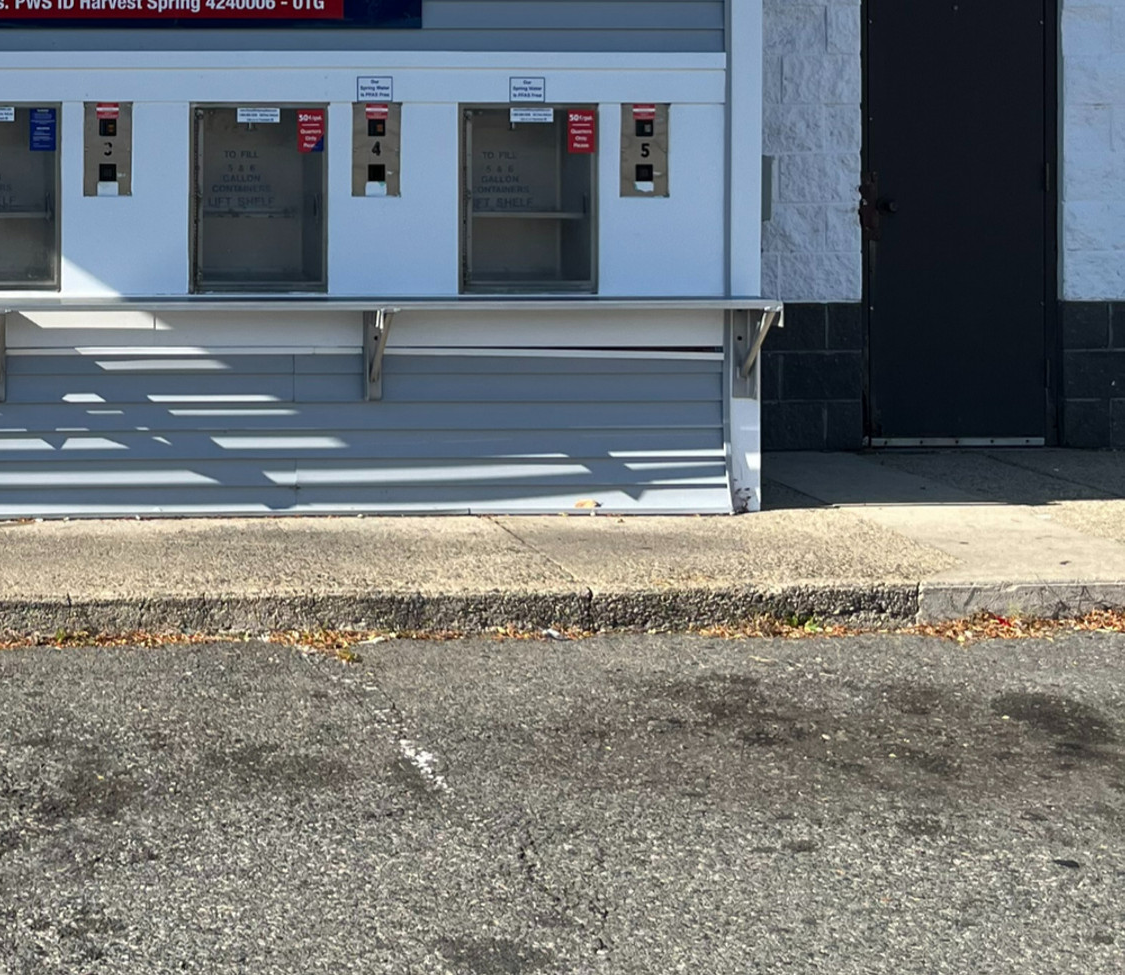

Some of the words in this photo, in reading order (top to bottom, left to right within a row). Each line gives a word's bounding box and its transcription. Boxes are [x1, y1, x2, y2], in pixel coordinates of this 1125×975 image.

[103, 142, 113, 156] 3
[224, 150, 236, 159] TO
[241, 150, 259, 158] FILL
[371, 141, 381, 157] 4
[641, 143, 650, 158] 5
[481, 151, 494, 159] TO
[499, 151, 517, 159] FILL
[222, 175, 261, 183] GALLON
[211, 185, 272, 193] CONTAINERS
[208, 197, 232, 208] LIFT
[237, 197, 275, 208] SHELF
[497, 197, 534, 208] SHELF
